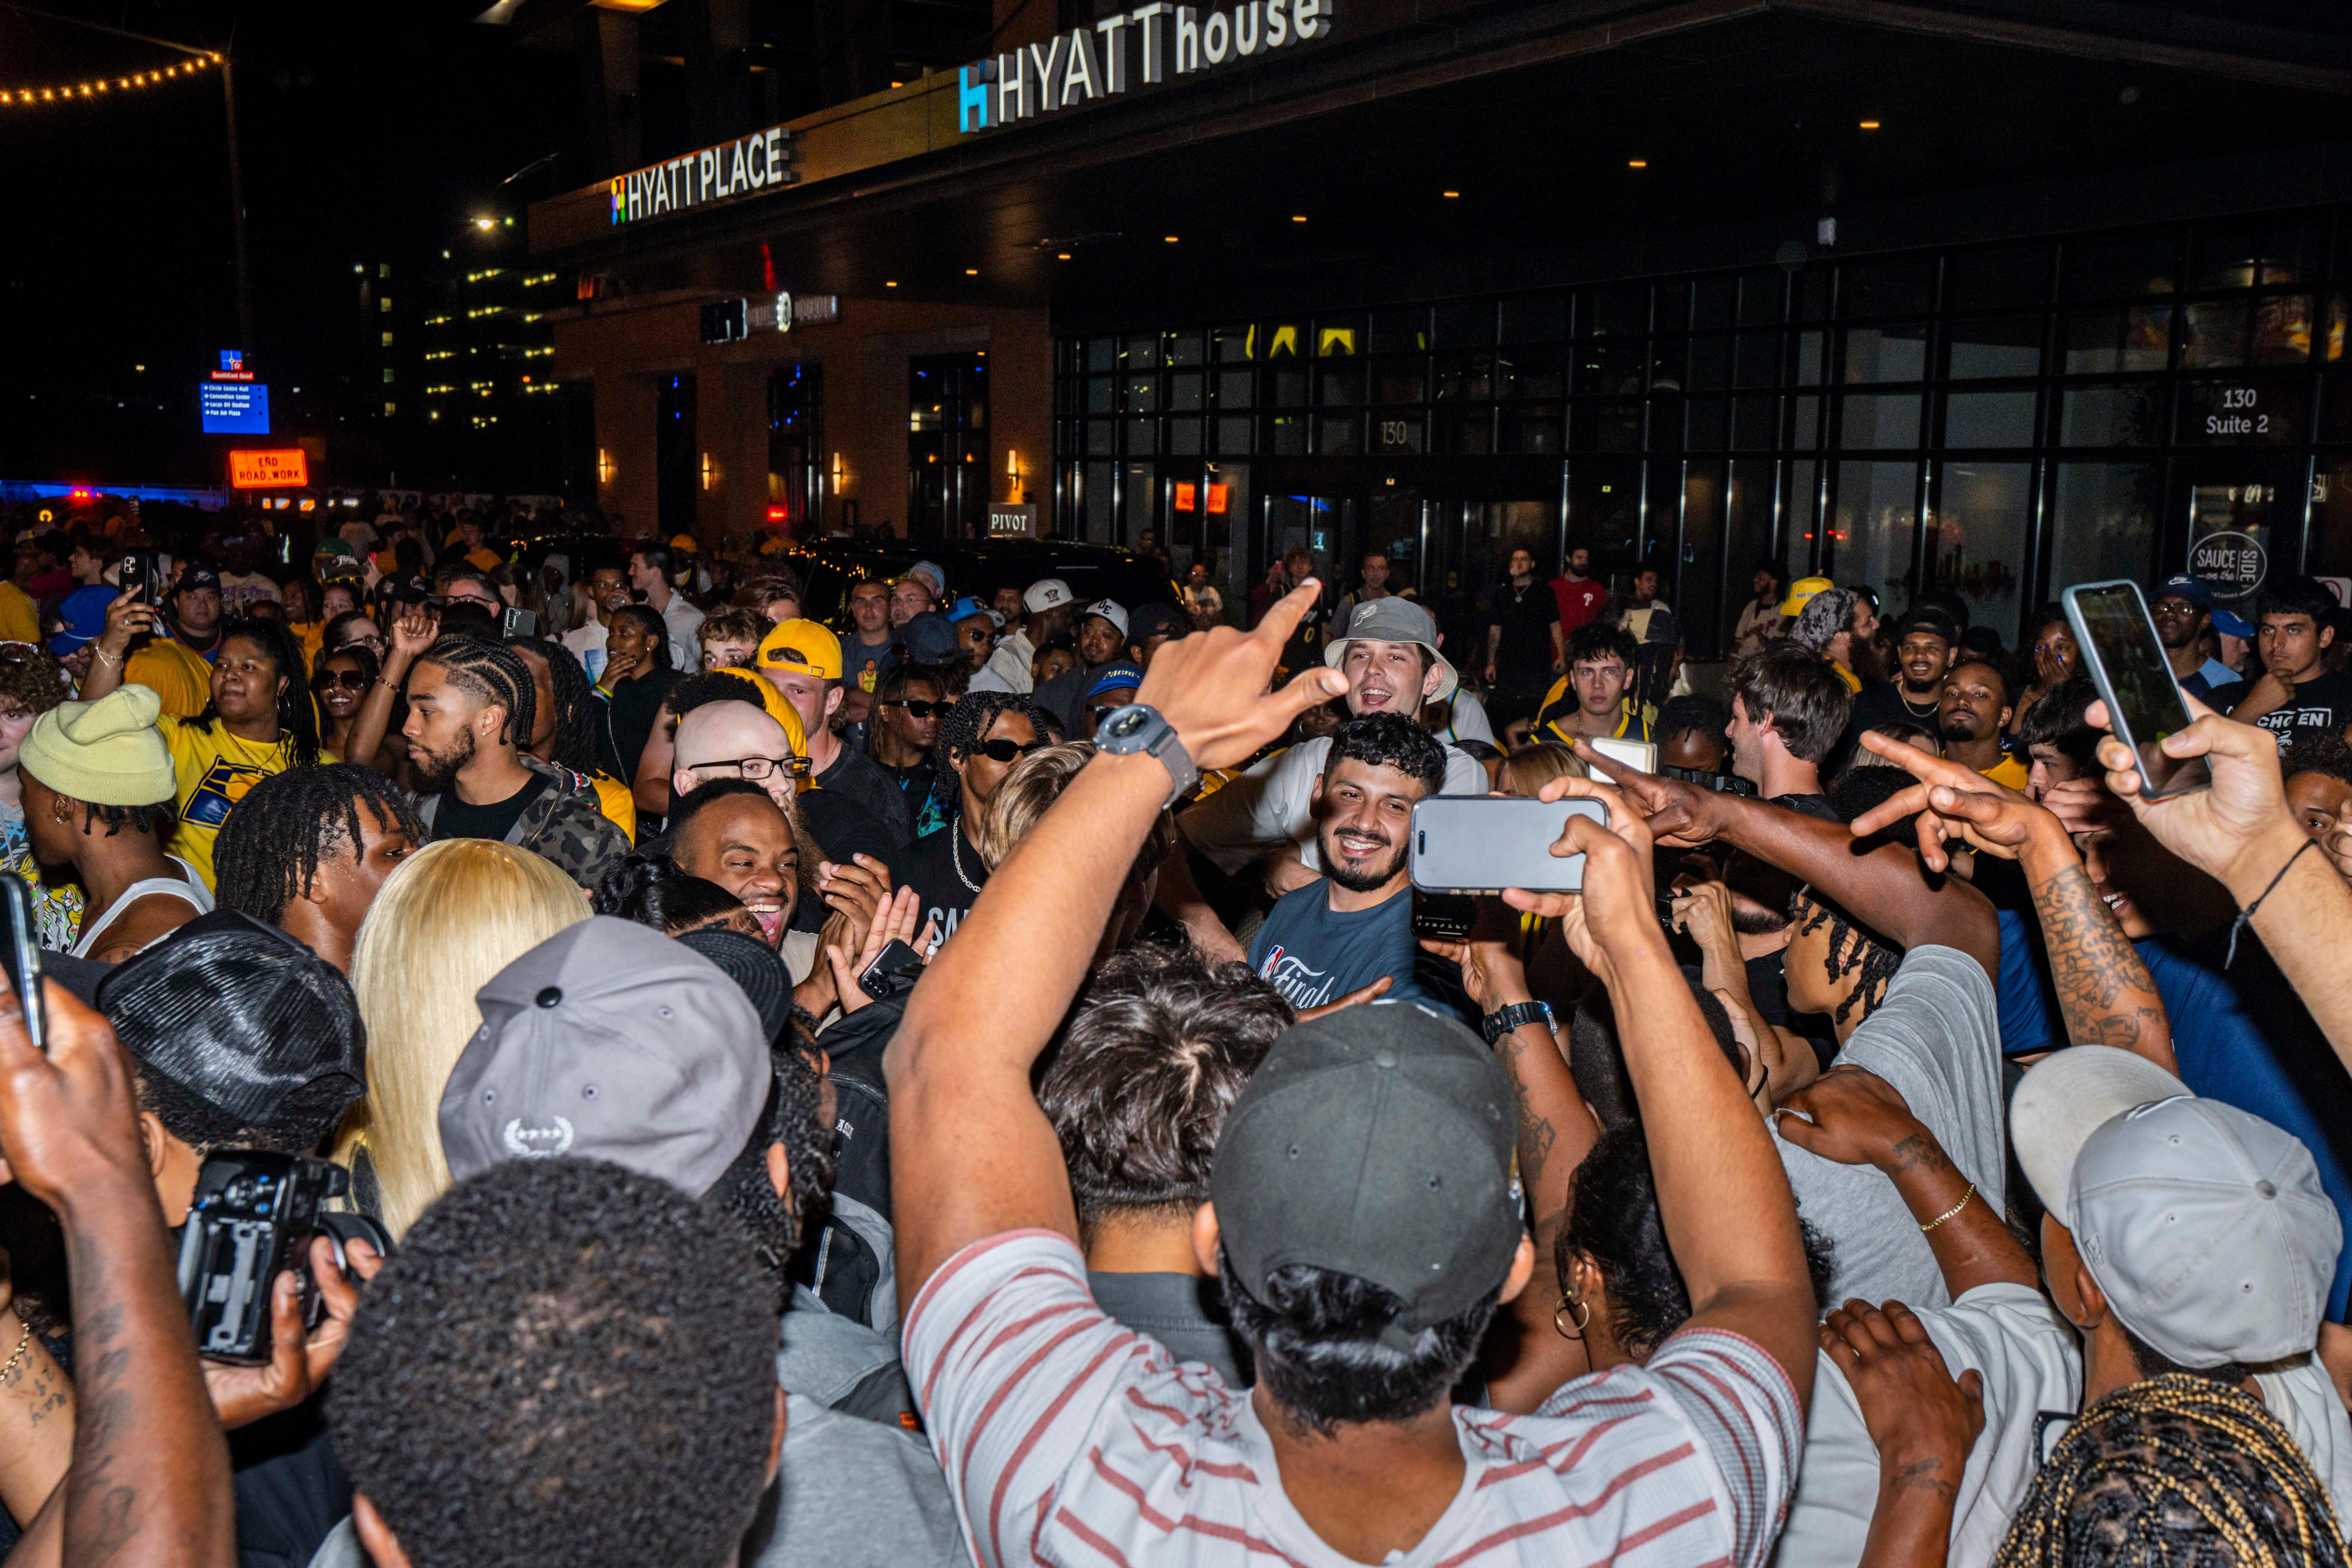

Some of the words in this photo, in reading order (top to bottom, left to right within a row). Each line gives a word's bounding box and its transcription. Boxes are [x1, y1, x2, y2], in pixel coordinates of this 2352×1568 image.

[999, 2, 1163, 122] HYATT
[1177, 0, 1320, 73] house
[627, 155, 695, 221] HYATT
[700, 127, 782, 201] PLACE
[2223, 389, 2256, 408] 130
[1382, 421, 1407, 445] 130
[2206, 414, 2251, 433] Suite
[2256, 414, 2269, 433] 2
[259, 457, 278, 467] END
[239, 470, 266, 481] ROAD
[272, 470, 300, 479] WORK
[991, 514, 1027, 531] PIVOT
[2197, 549, 2236, 569] SAUCE
[2240, 550, 2258, 582] SIDE
[2219, 568, 2235, 580] the
[2256, 712, 2325, 729] CHOEN
